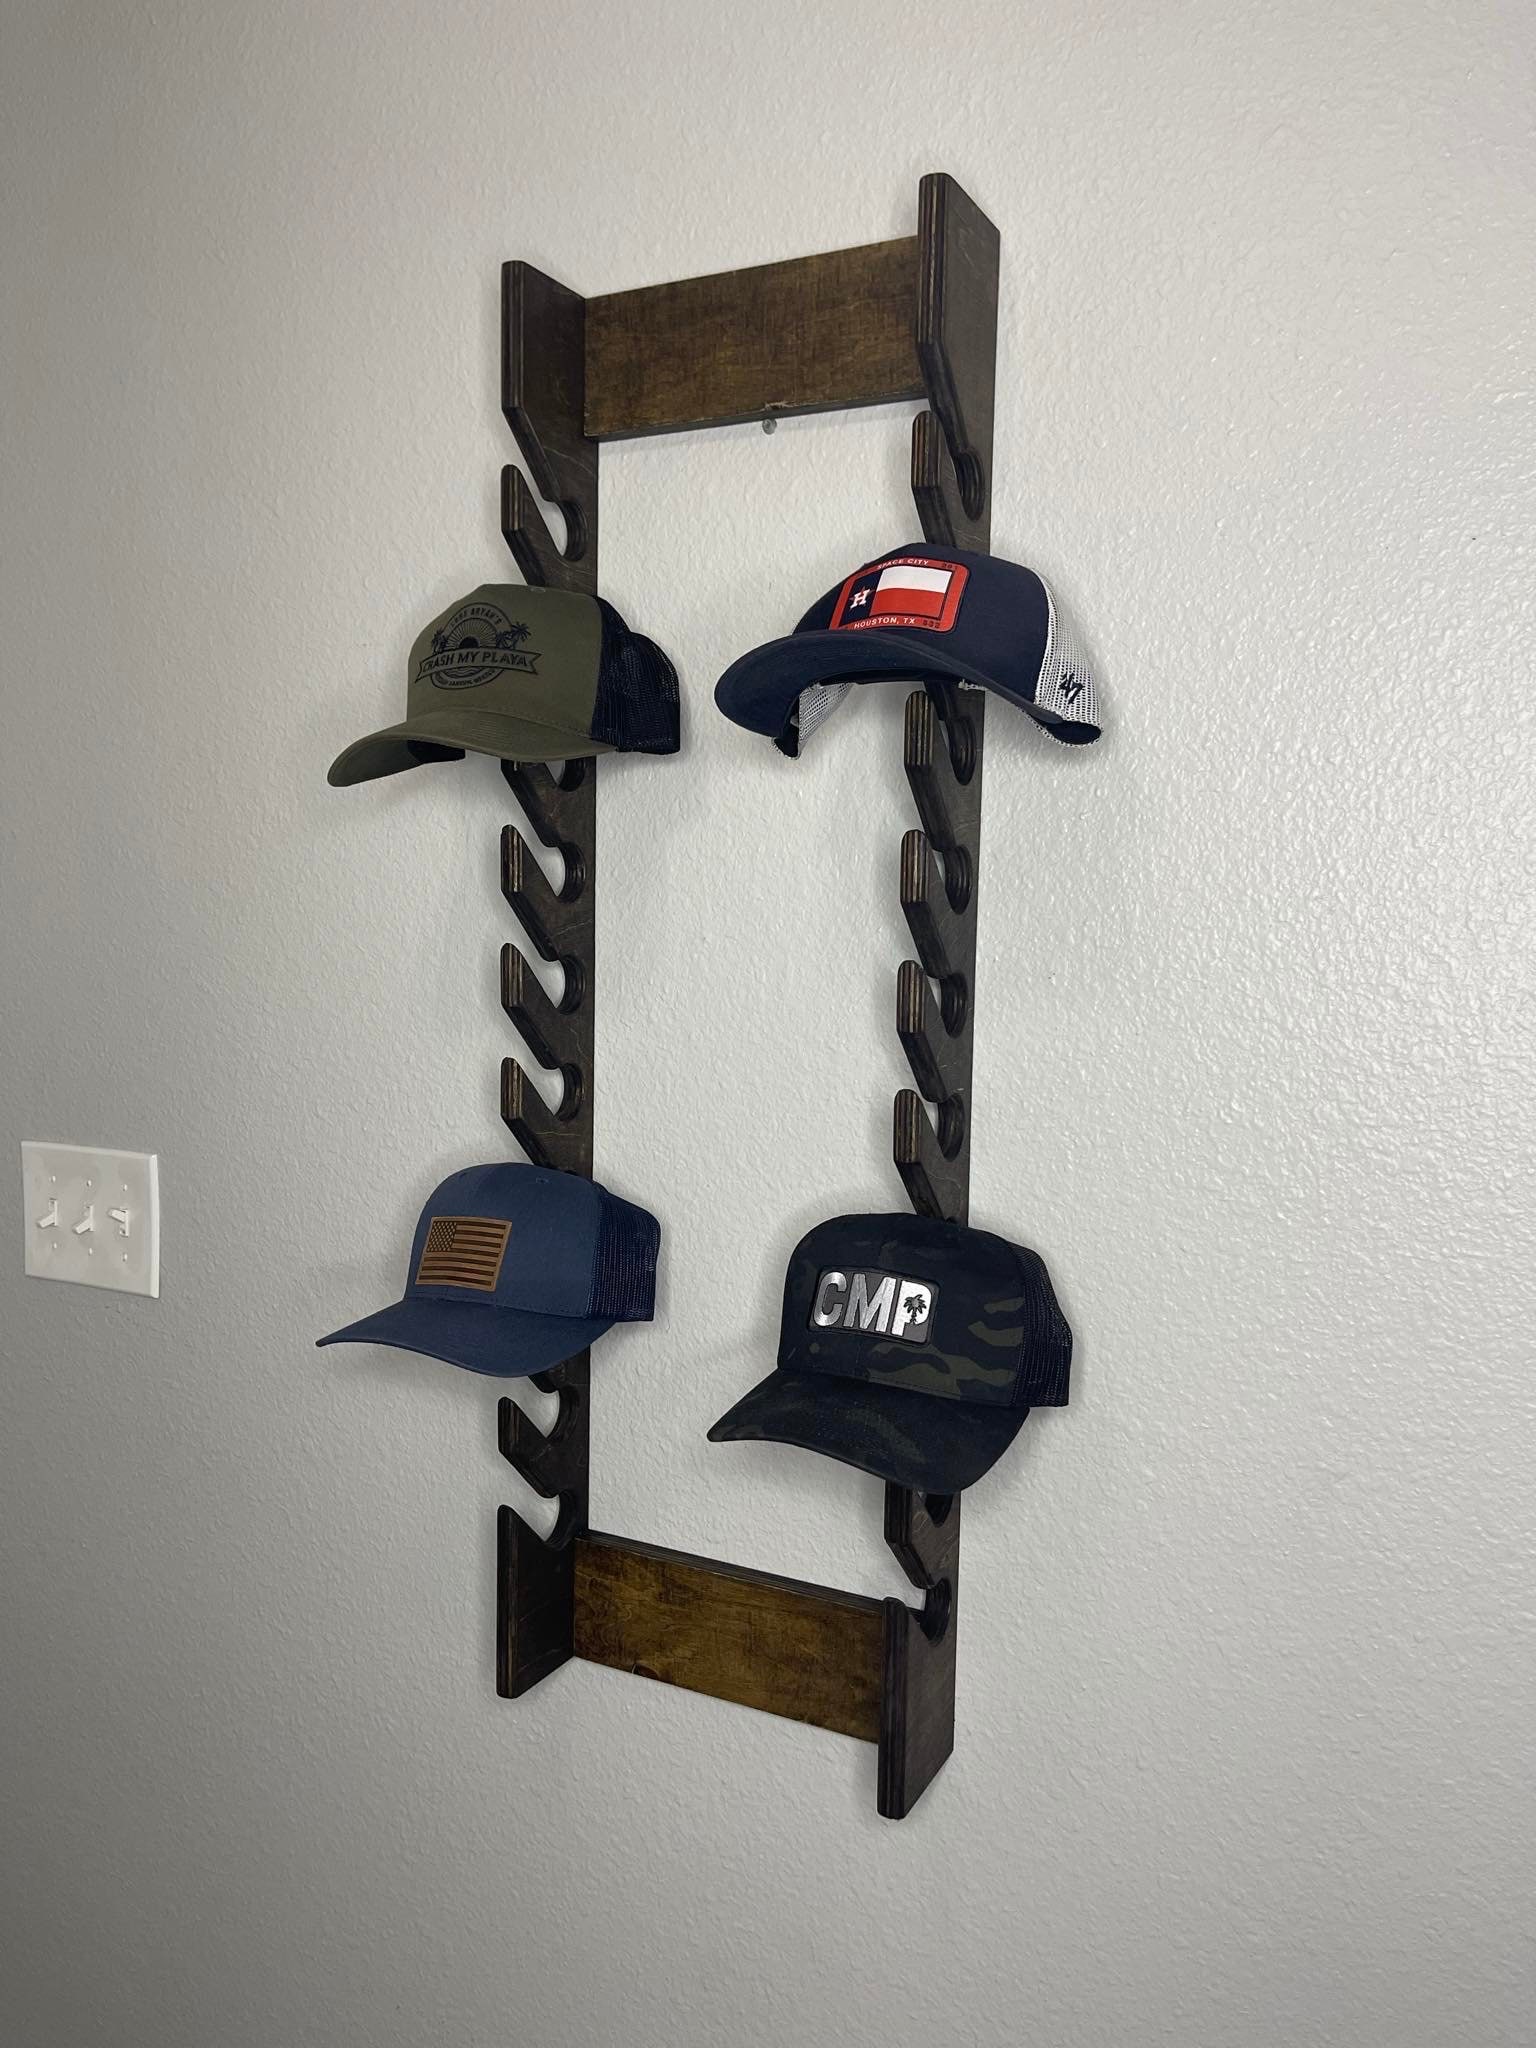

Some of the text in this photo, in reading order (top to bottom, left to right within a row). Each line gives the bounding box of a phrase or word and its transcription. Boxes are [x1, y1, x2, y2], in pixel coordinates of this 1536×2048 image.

[877, 558, 929, 570] SPACE CITY
[854, 617, 916, 630] HOUSTON, TX
[423, 650, 529, 673] CRASH MY PLAYA
[813, 1271, 932, 1337] CMP
